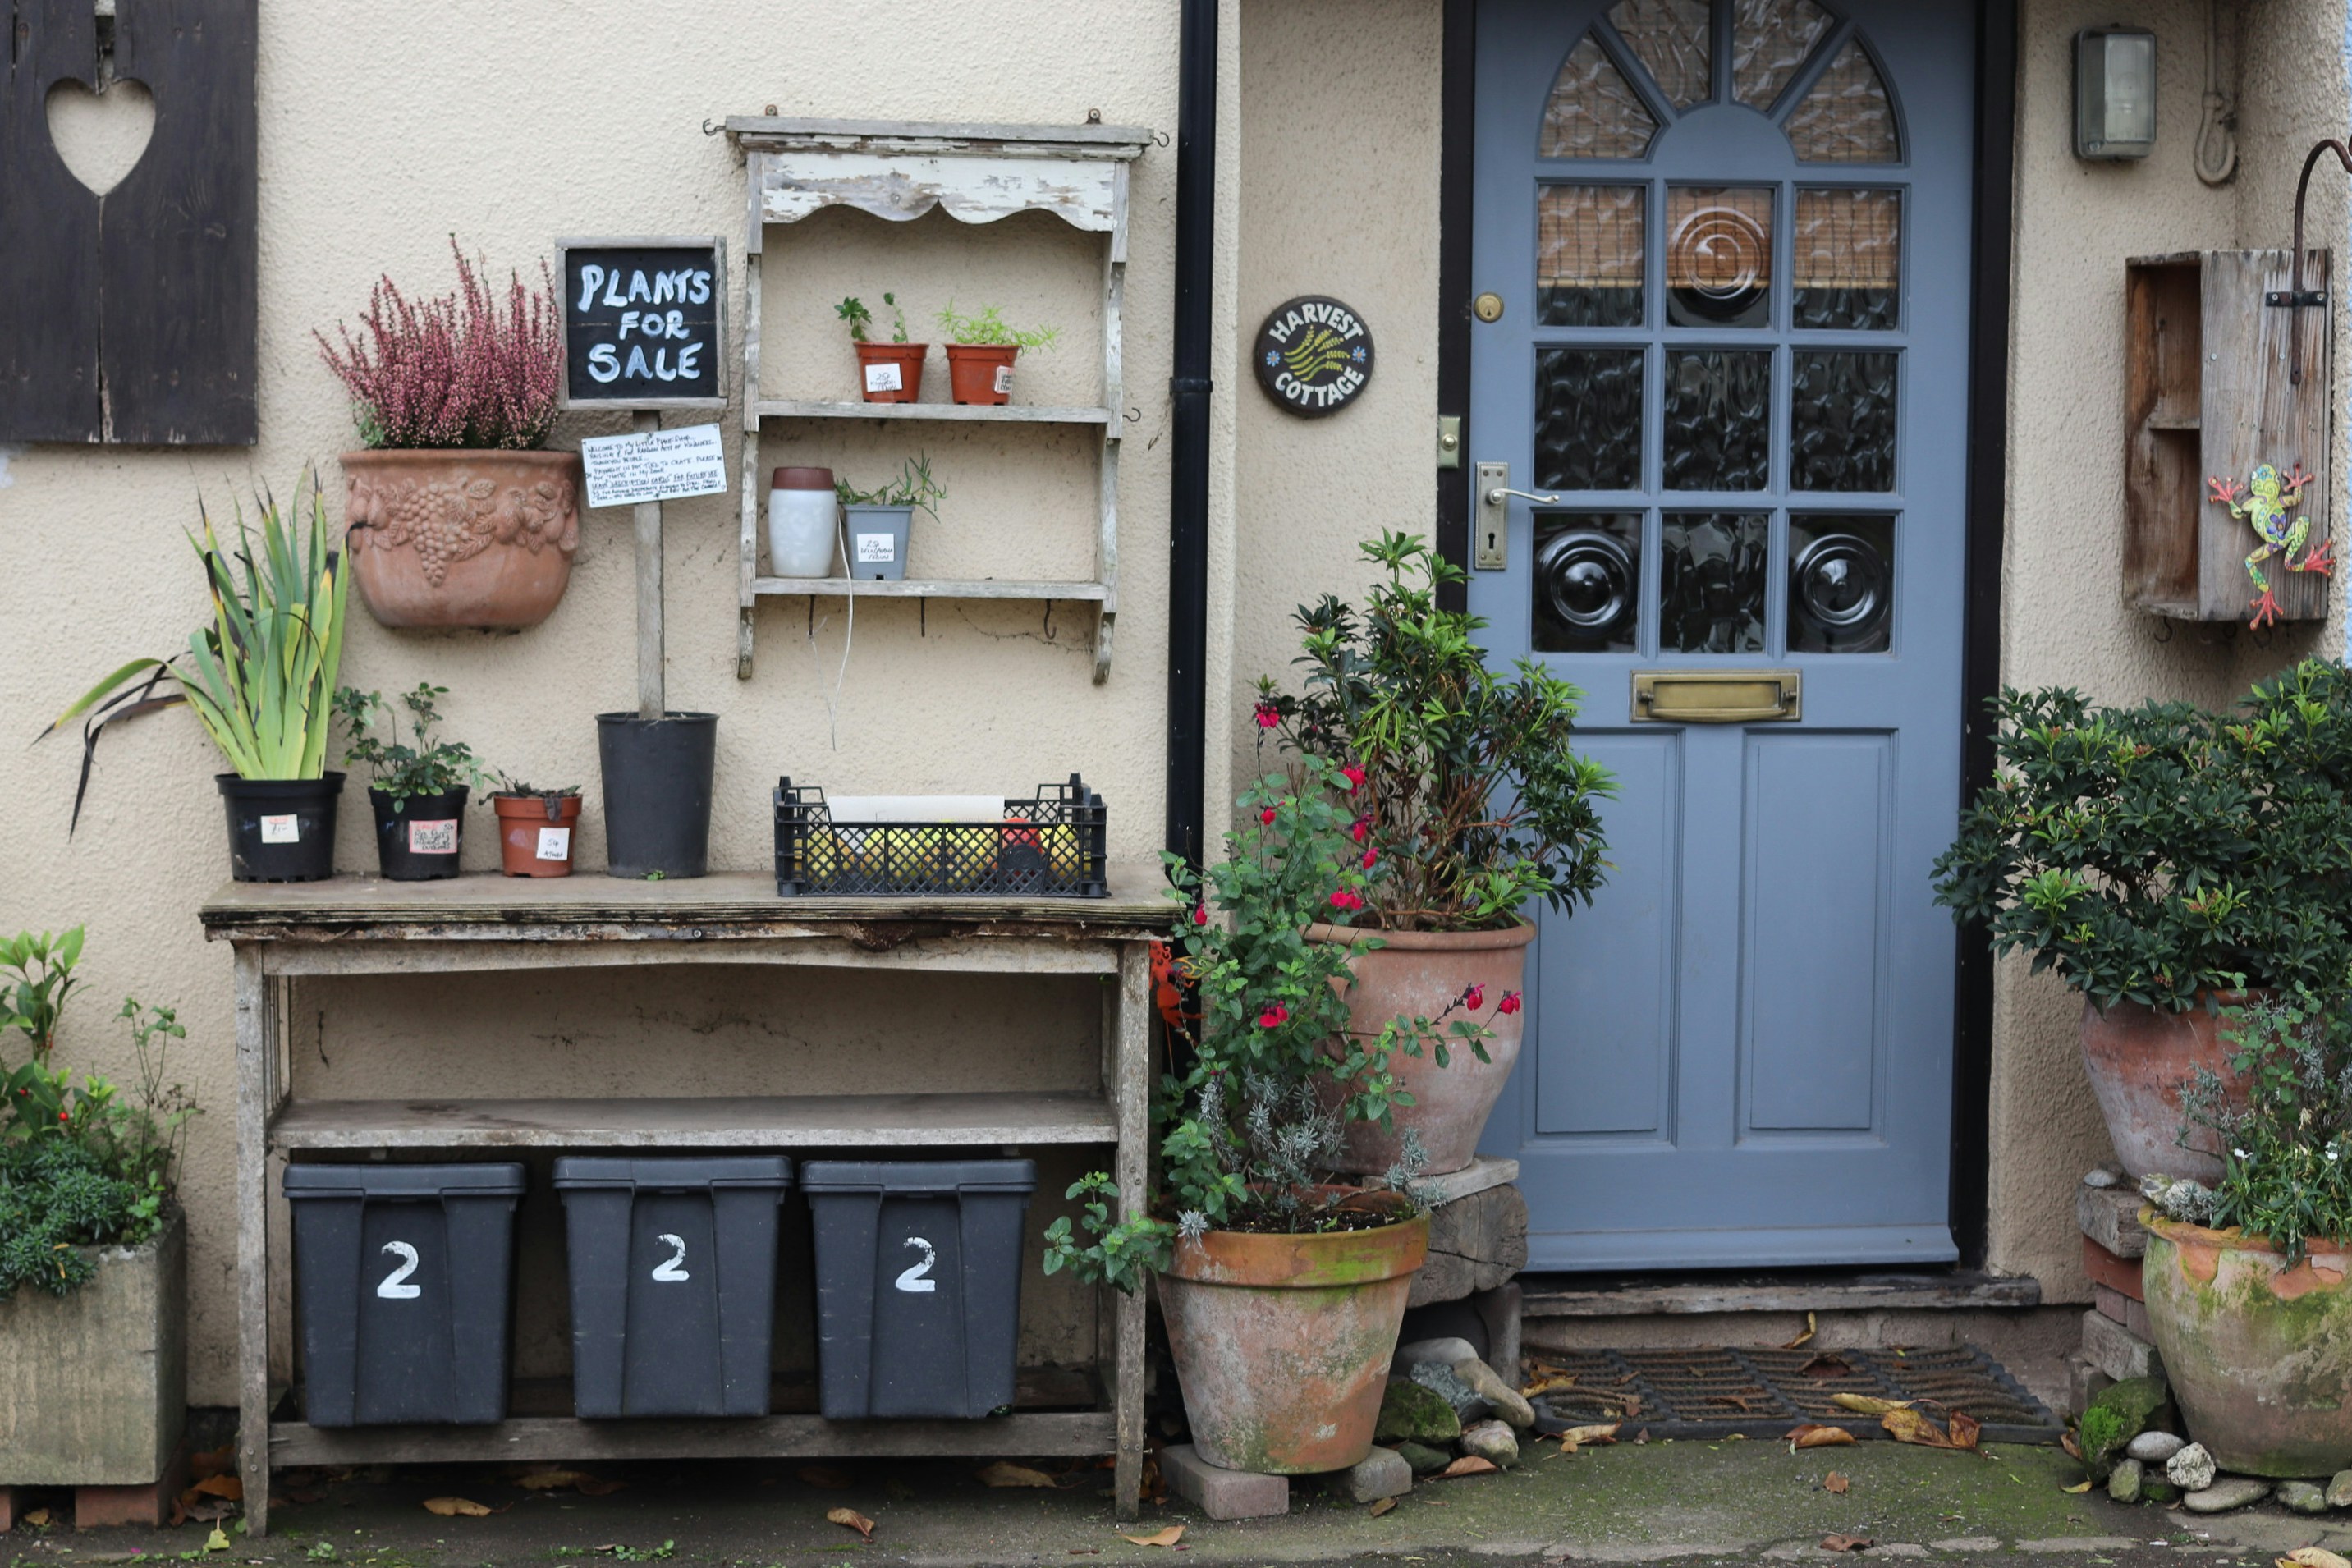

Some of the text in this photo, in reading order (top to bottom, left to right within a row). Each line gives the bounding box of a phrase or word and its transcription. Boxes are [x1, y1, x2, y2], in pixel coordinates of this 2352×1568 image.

[577, 264, 711, 313] PLANTS
[618, 309, 690, 341] FOR
[1268, 303, 1364, 344] HARVEST
[588, 342, 703, 383] SALE
[1274, 365, 1364, 407] COTTAGE
[377, 1240, 421, 1299] 2
[652, 1234, 690, 1281] 2
[895, 1236, 936, 1292] 2
